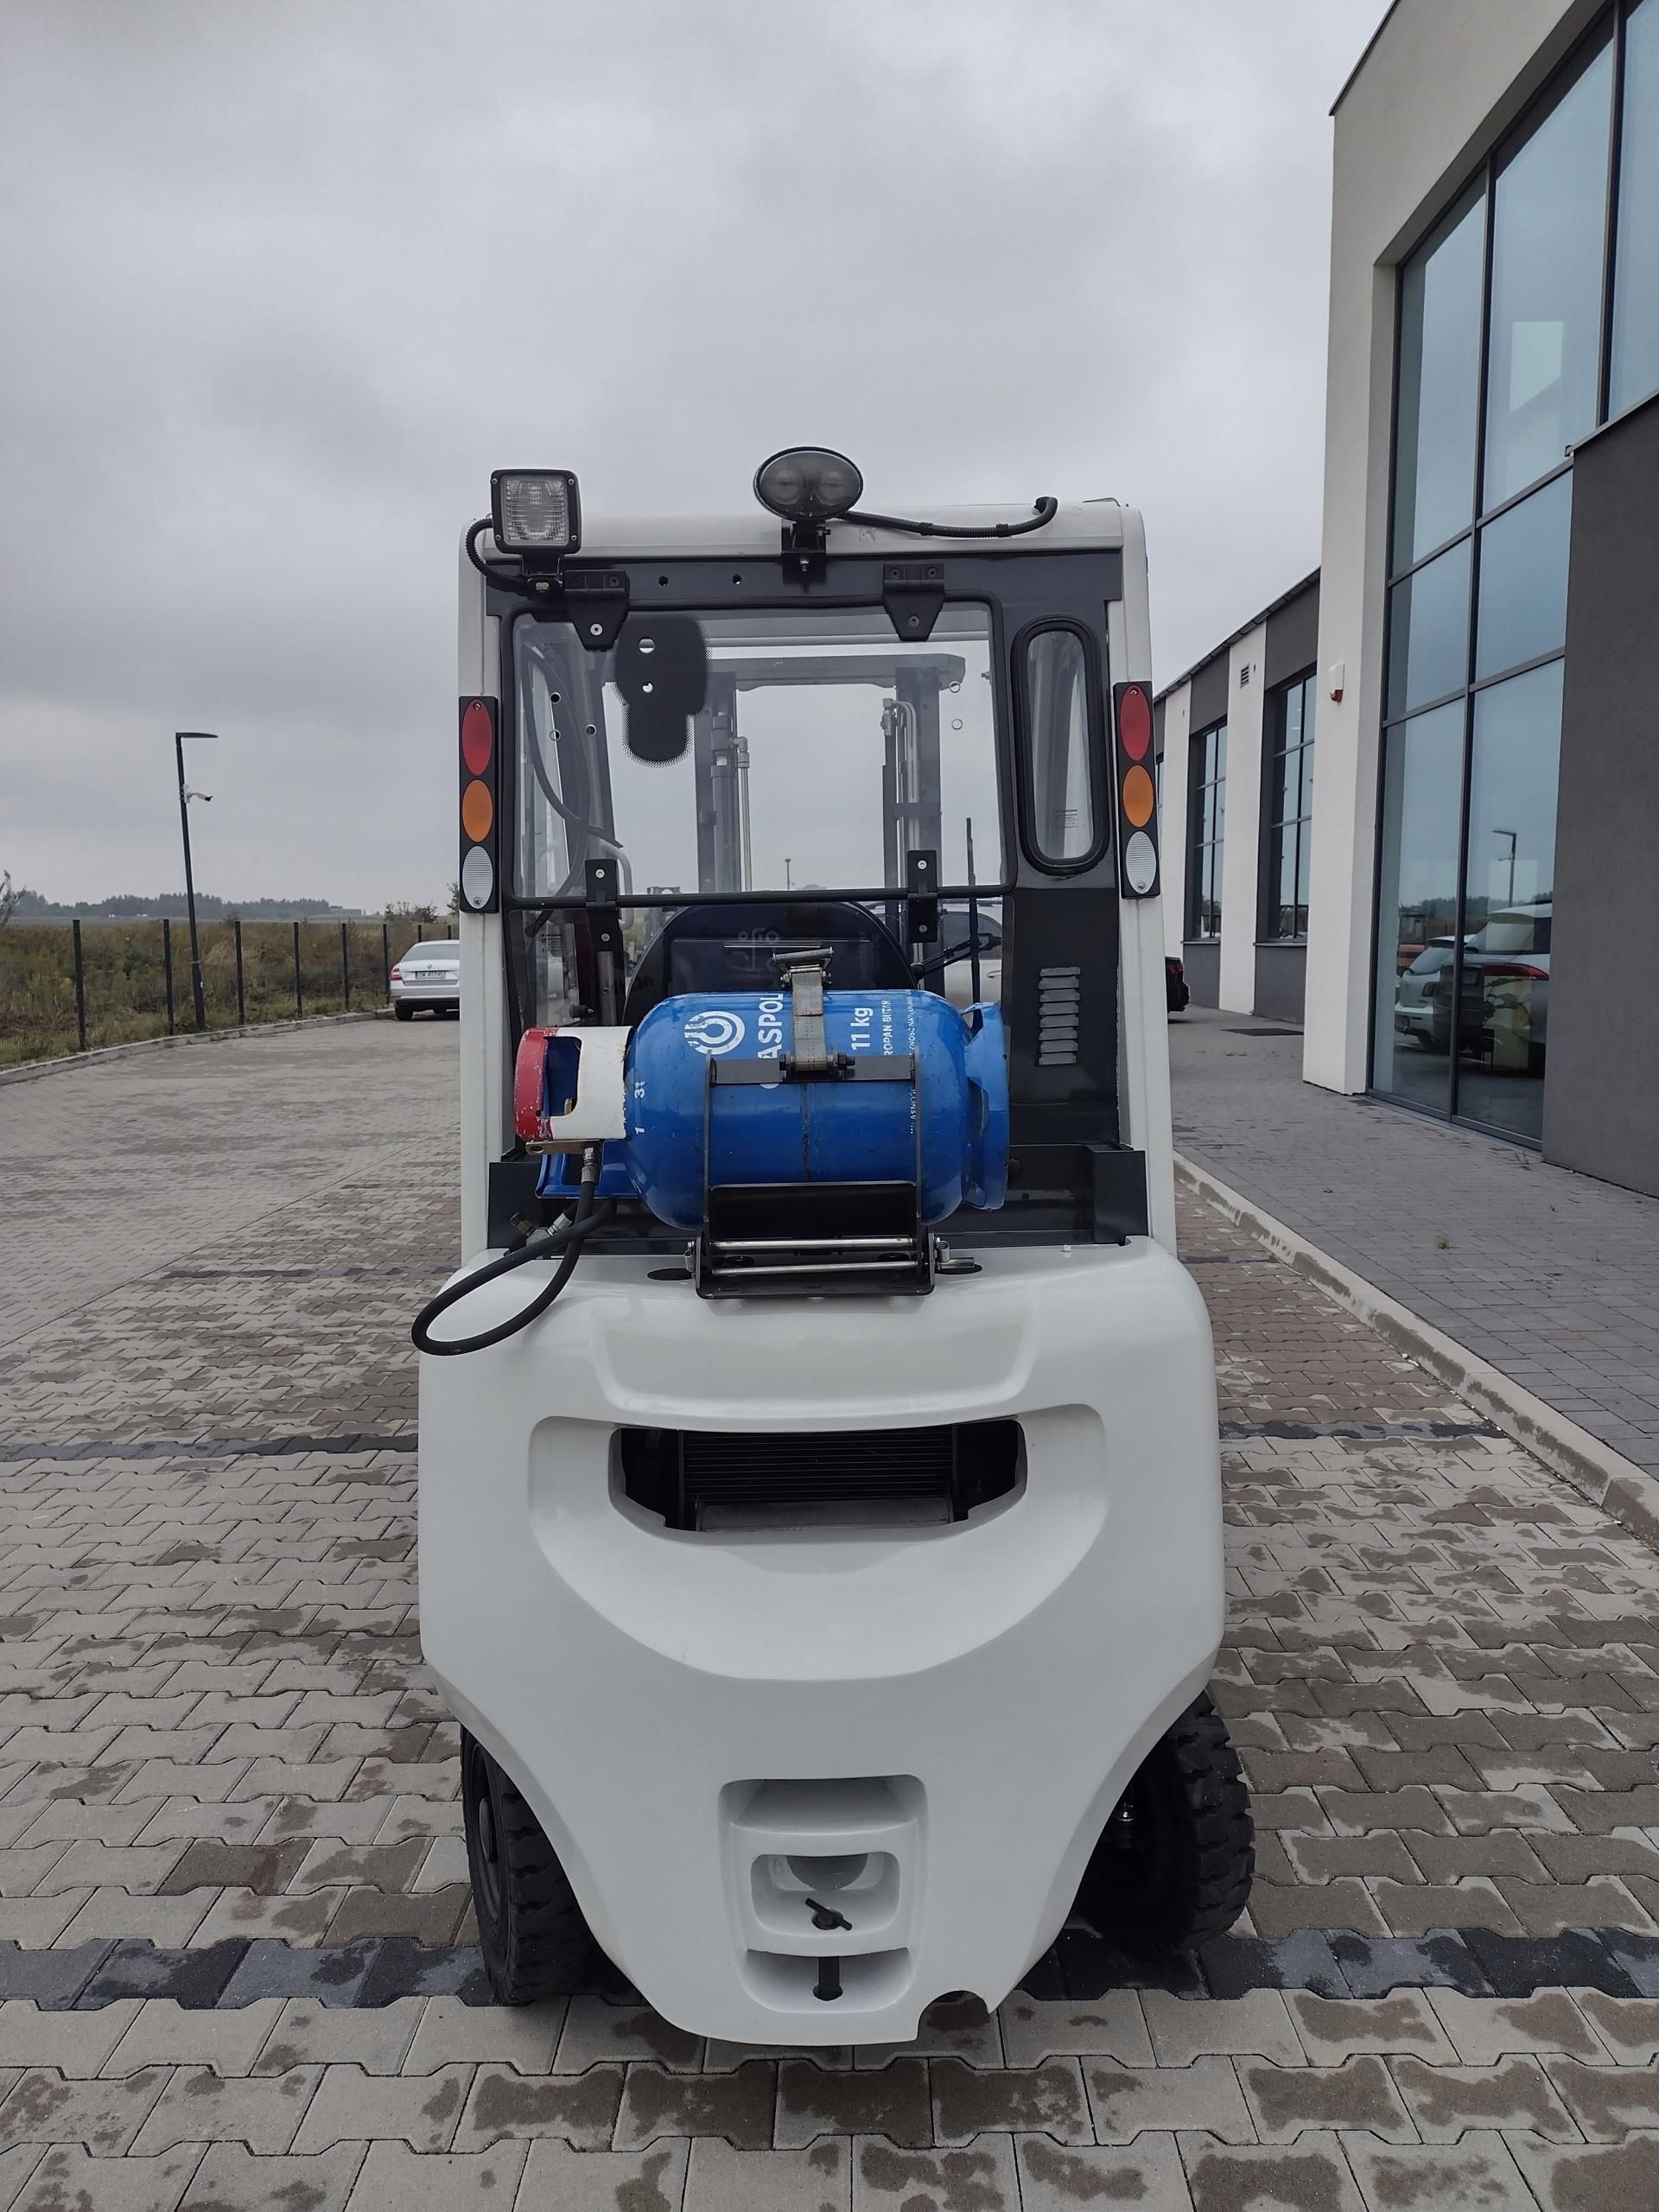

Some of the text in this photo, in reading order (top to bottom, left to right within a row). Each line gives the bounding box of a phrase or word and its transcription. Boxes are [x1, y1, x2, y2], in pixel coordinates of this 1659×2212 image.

[757, 994, 784, 1089] ASPOL
[850, 1007, 874, 1051] 11 kg
[883, 1026, 893, 1056] ROPAN
